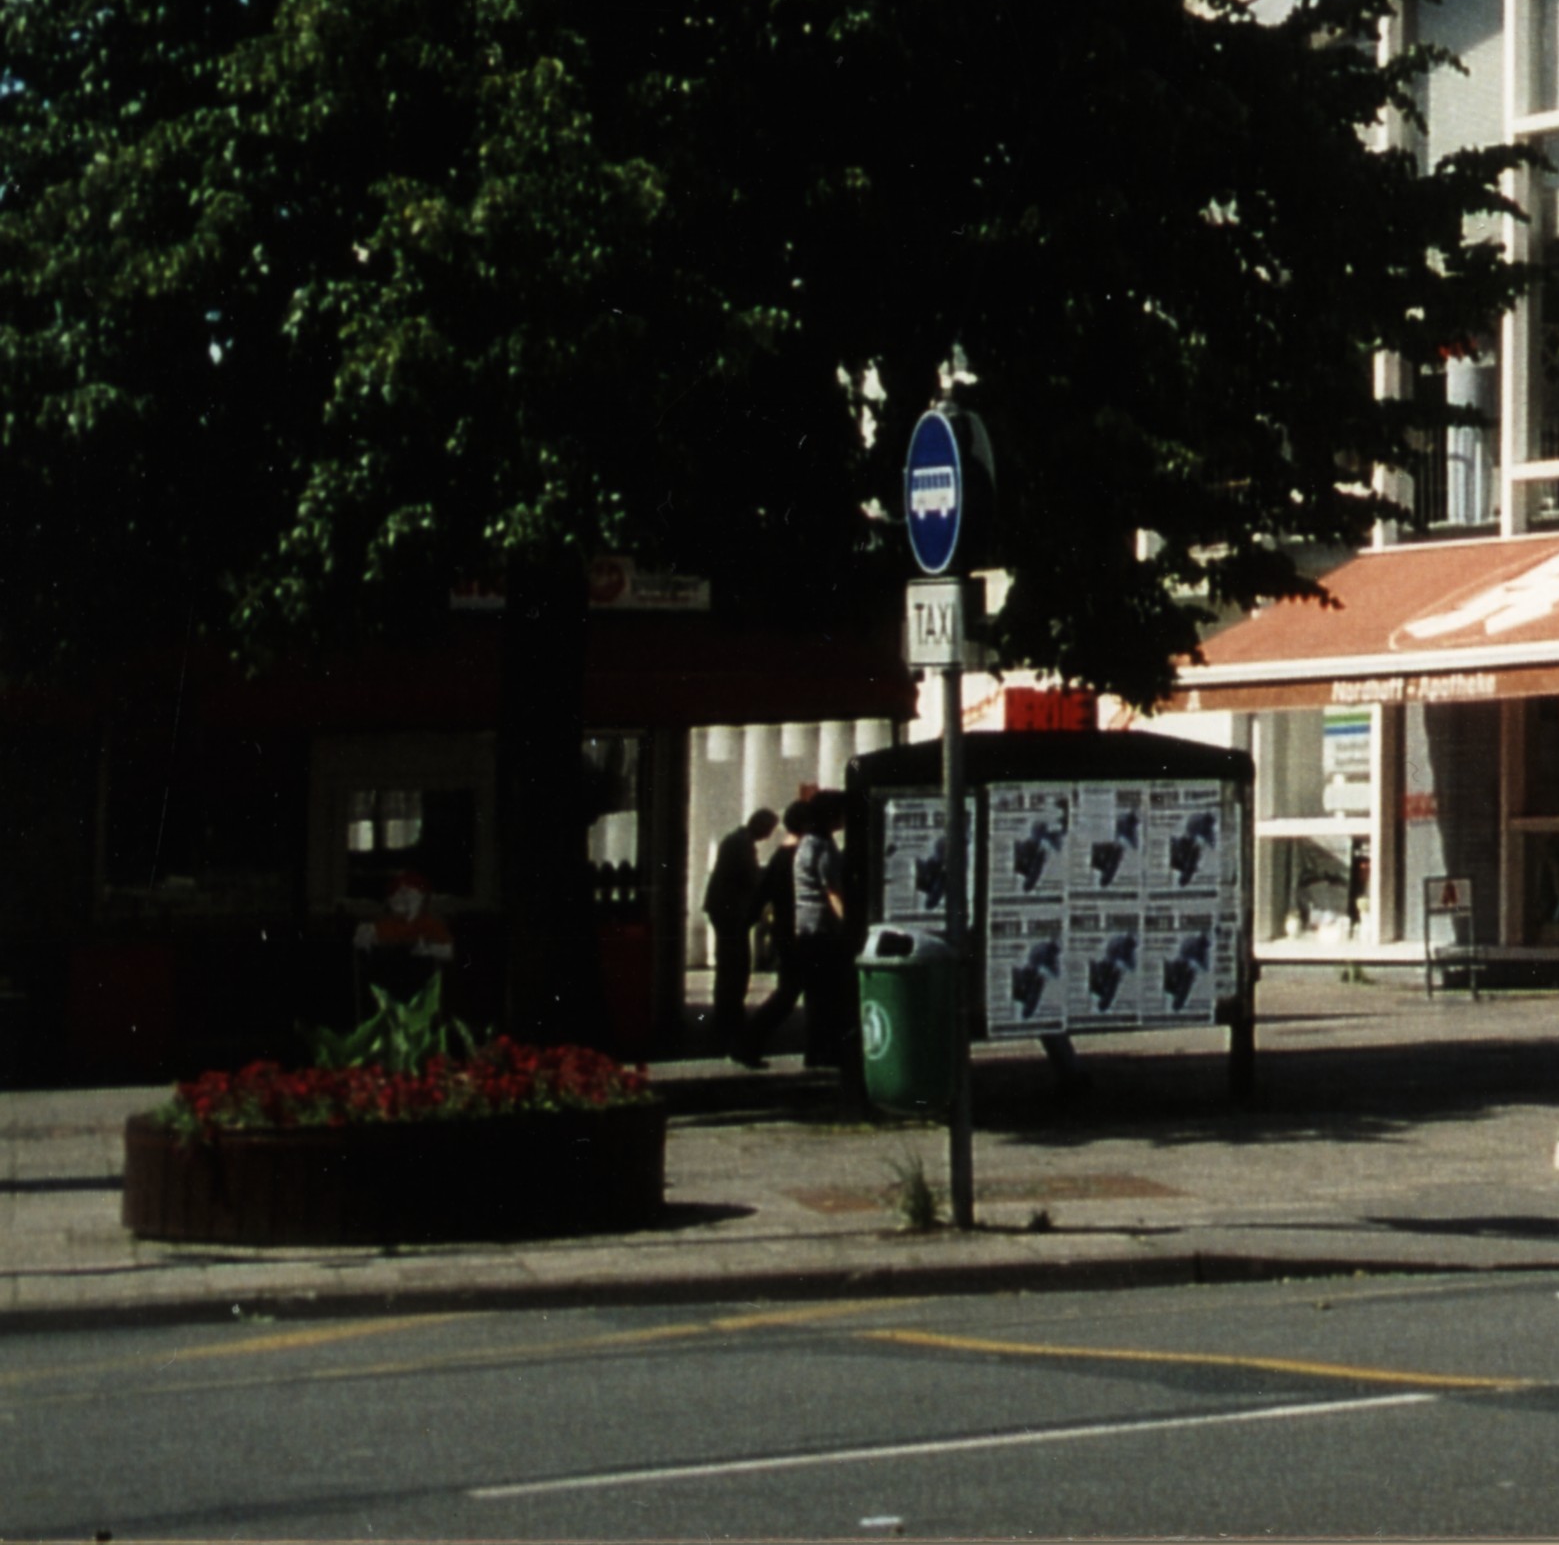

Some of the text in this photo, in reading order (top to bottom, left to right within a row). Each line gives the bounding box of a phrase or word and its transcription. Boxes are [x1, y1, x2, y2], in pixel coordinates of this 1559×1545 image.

[914, 602, 957, 645] TAXI
[1332, 678, 1404, 702] Nordhoff
[1418, 672, 1496, 702] Apotheke
